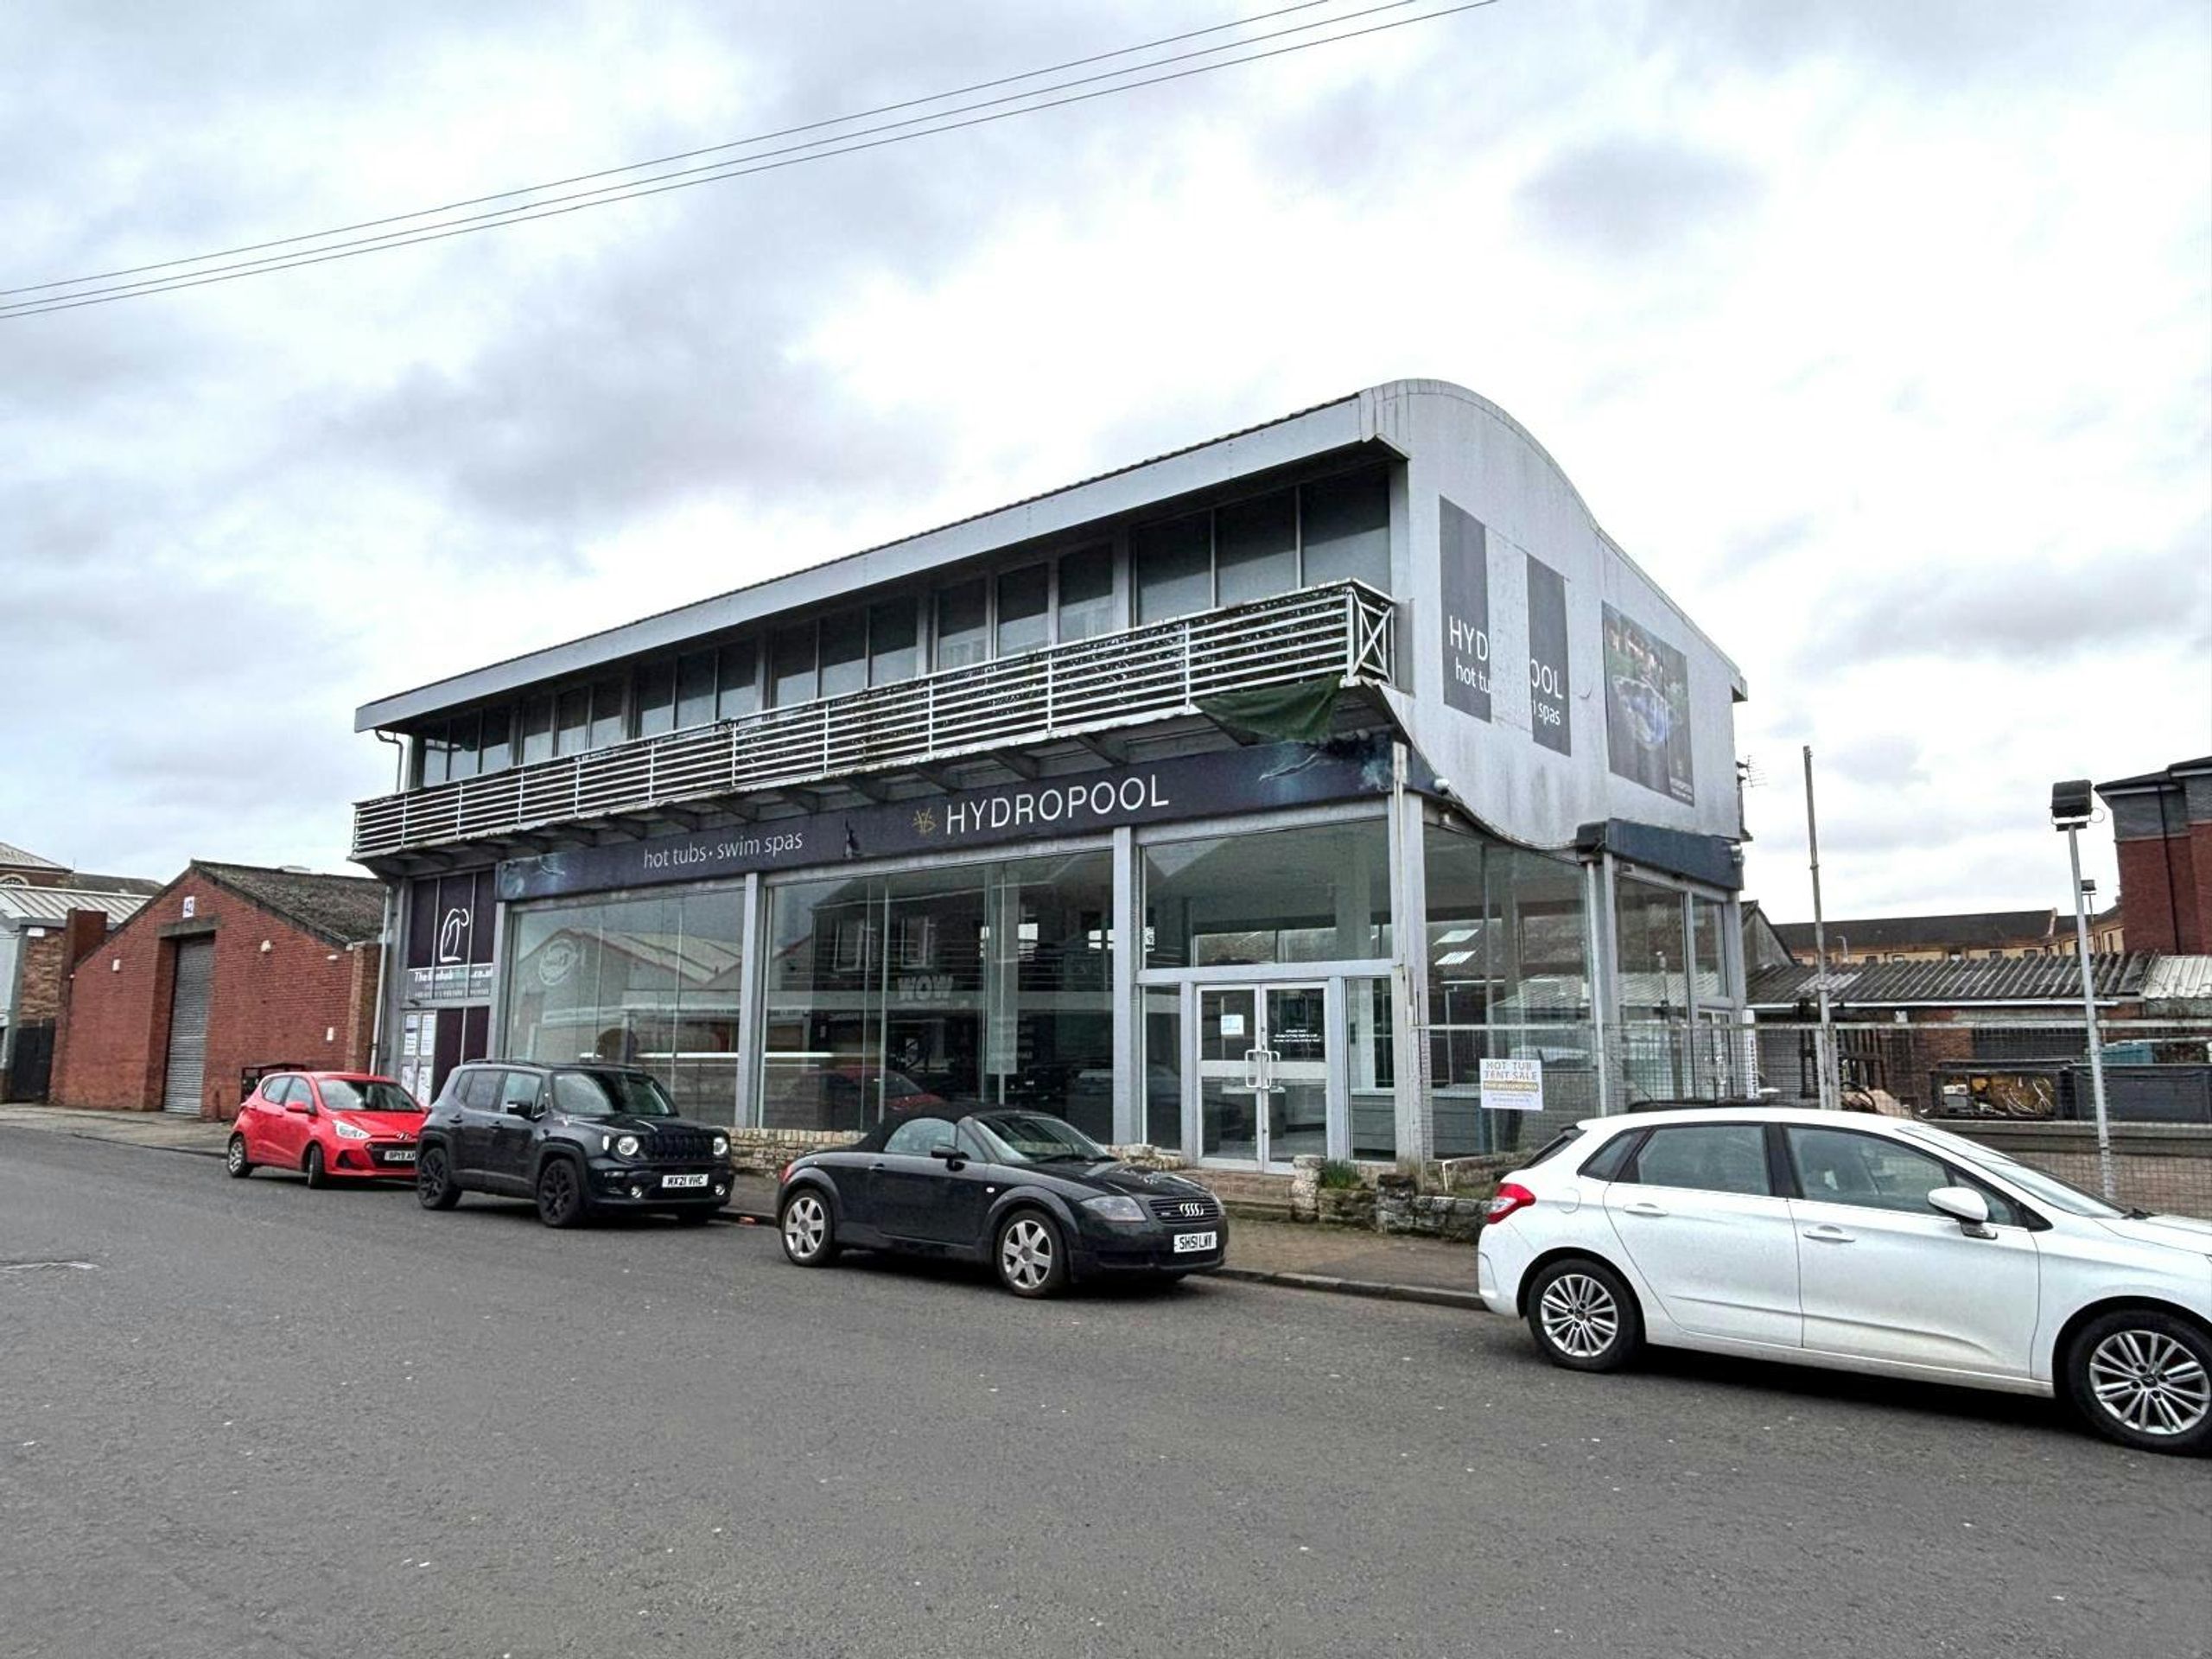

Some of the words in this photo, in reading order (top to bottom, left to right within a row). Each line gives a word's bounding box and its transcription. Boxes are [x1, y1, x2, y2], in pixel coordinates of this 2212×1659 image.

[1449, 614, 1489, 662] HYD
[1455, 656, 1477, 688] hot
[1538, 702, 1560, 726] spas
[946, 773, 1170, 836] HYDROPOOL
[643, 849, 670, 869] hot
[716, 835, 760, 860] swim
[764, 831, 804, 857] spas
[1484, 1071, 1509, 1079] TENT
[1512, 1071, 1538, 1081] SALE
[1485, 1061, 1506, 1070] HOT
[1513, 1062, 1533, 1071] TUB
